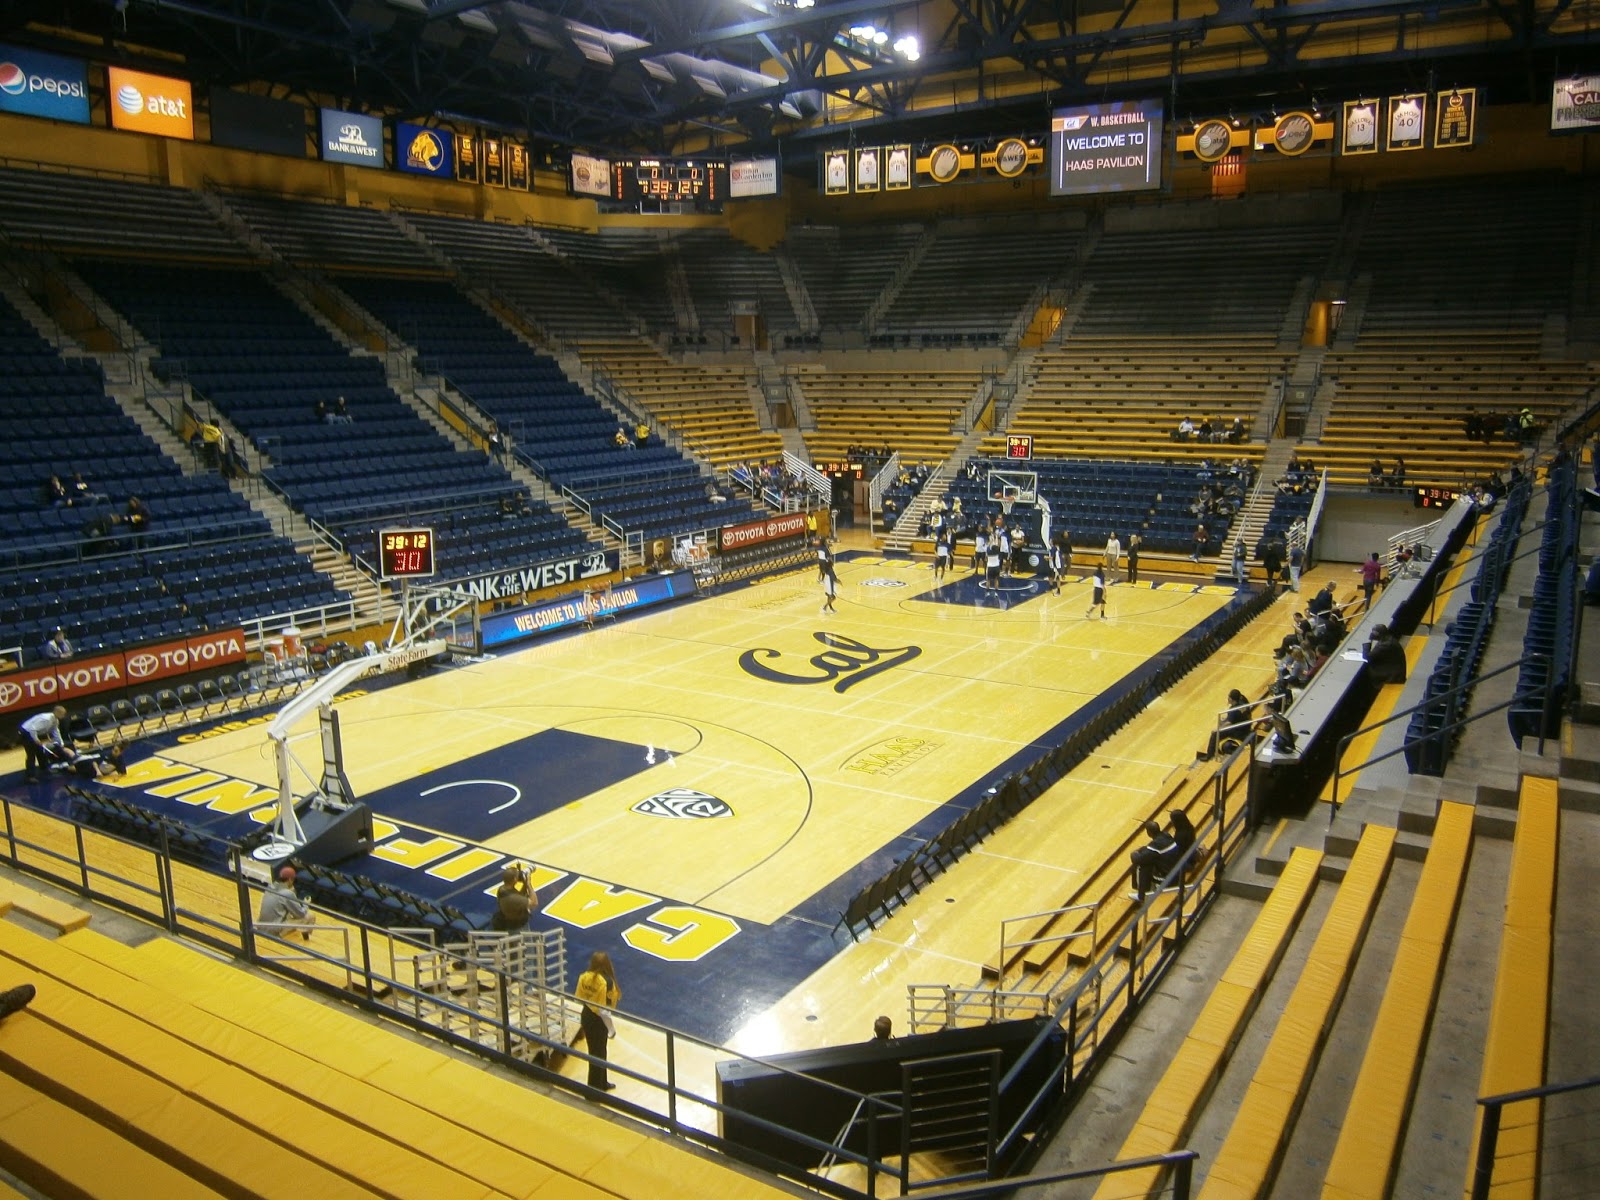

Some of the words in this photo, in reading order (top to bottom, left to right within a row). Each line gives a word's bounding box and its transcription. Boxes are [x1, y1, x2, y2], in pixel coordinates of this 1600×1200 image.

[148, 95, 187, 119] at&t
[1101, 112, 1145, 126] BASKETBALL
[1398, 118, 1414, 127] 40
[1357, 124, 1365, 132] 13
[329, 140, 350, 153] BANK
[355, 146, 378, 157] WEST
[1066, 134, 1125, 151] WELCOME
[1128, 132, 1144, 145] TO
[1066, 160, 1094, 172] HAAS
[1096, 156, 1144, 170] PAVILION
[777, 518, 804, 533] TOYOTA
[386, 535, 427, 550] 39:12
[735, 528, 765, 543] TOYOTA
[503, 573, 518, 585] OF
[520, 559, 579, 592] WEST
[500, 583, 521, 597] THE
[514, 607, 565, 632] WELCOME
[564, 604, 576, 620] TO
[161, 639, 241, 668] TOYOTA
[738, 631, 922, 694] Cal
[24, 663, 121, 697] TOYOTA
[845, 736, 926, 775] HAAS
